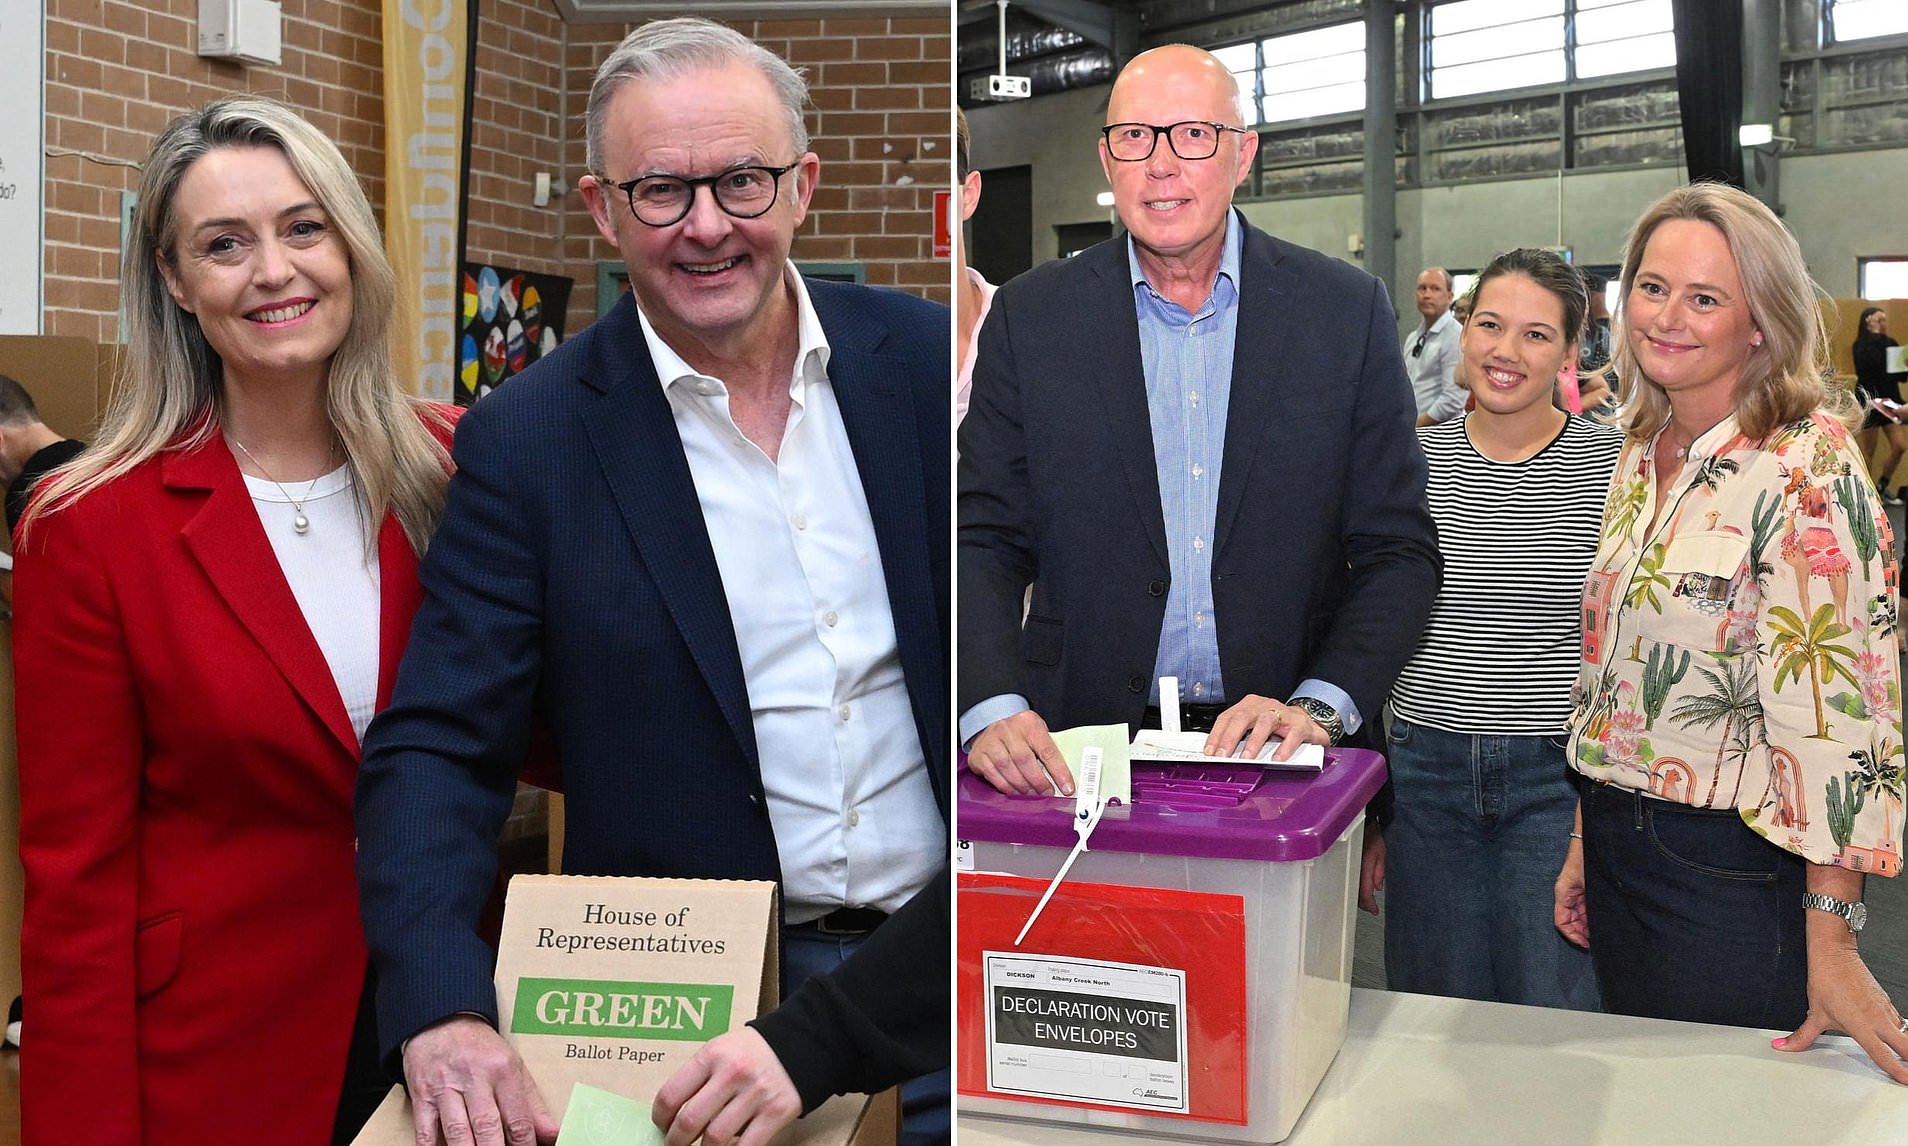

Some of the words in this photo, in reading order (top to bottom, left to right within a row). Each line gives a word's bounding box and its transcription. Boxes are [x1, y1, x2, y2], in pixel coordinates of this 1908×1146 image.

[582, 903, 657, 926] House
[664, 907, 690, 927] of
[535, 928, 726, 955] Representatives
[1051, 975, 1073, 984] Albany
[1073, 977, 1092, 985] Creek
[1092, 979, 1111, 987] North
[535, 990, 711, 1031] GREEN
[1002, 996, 1120, 1022] DECLARATION
[1125, 1008, 1170, 1029] VOTE
[1035, 1023, 1137, 1048] ENVELOPES
[565, 1043, 613, 1061] Ballot
[618, 1046, 666, 1065] Paper
